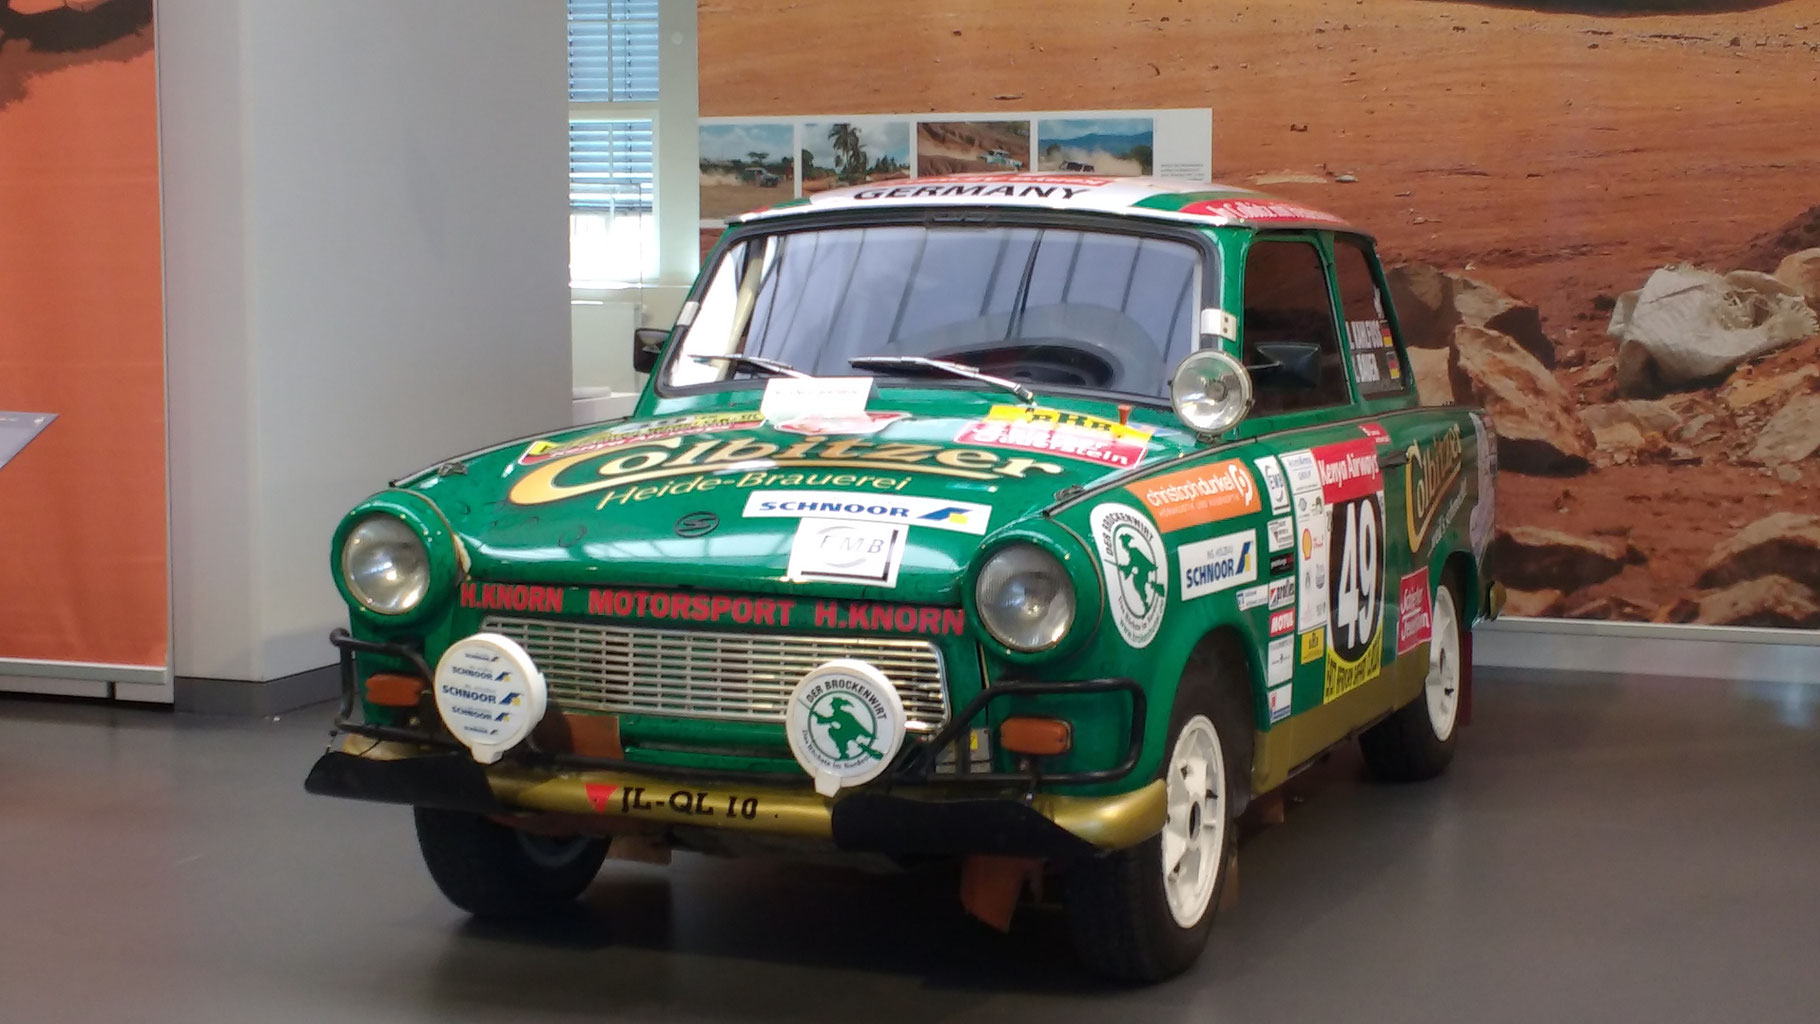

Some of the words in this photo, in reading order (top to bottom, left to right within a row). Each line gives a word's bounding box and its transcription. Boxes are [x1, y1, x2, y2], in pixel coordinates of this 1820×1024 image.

[853, 184, 1091, 200] GERMANY
[508, 435, 1064, 505] Colbitzer
[1317, 460, 1348, 488] Kenya
[1346, 453, 1379, 480] Airways
[596, 472, 913, 511] Heide-Brauerei
[759, 501, 910, 517] SCHNOOR
[1186, 558, 1235, 589] SCHNOOR
[1338, 499, 1377, 649] 49
[460, 582, 565, 613] H.KNORN
[587, 588, 796, 626] MOTORSPORT
[814, 600, 966, 636] H.KNORN
[452, 666, 493, 681] SCHNOOR
[442, 685, 497, 704] SCHNOOR
[806, 685, 824, 703] DER
[825, 679, 888, 721] BROCKENWIRT
